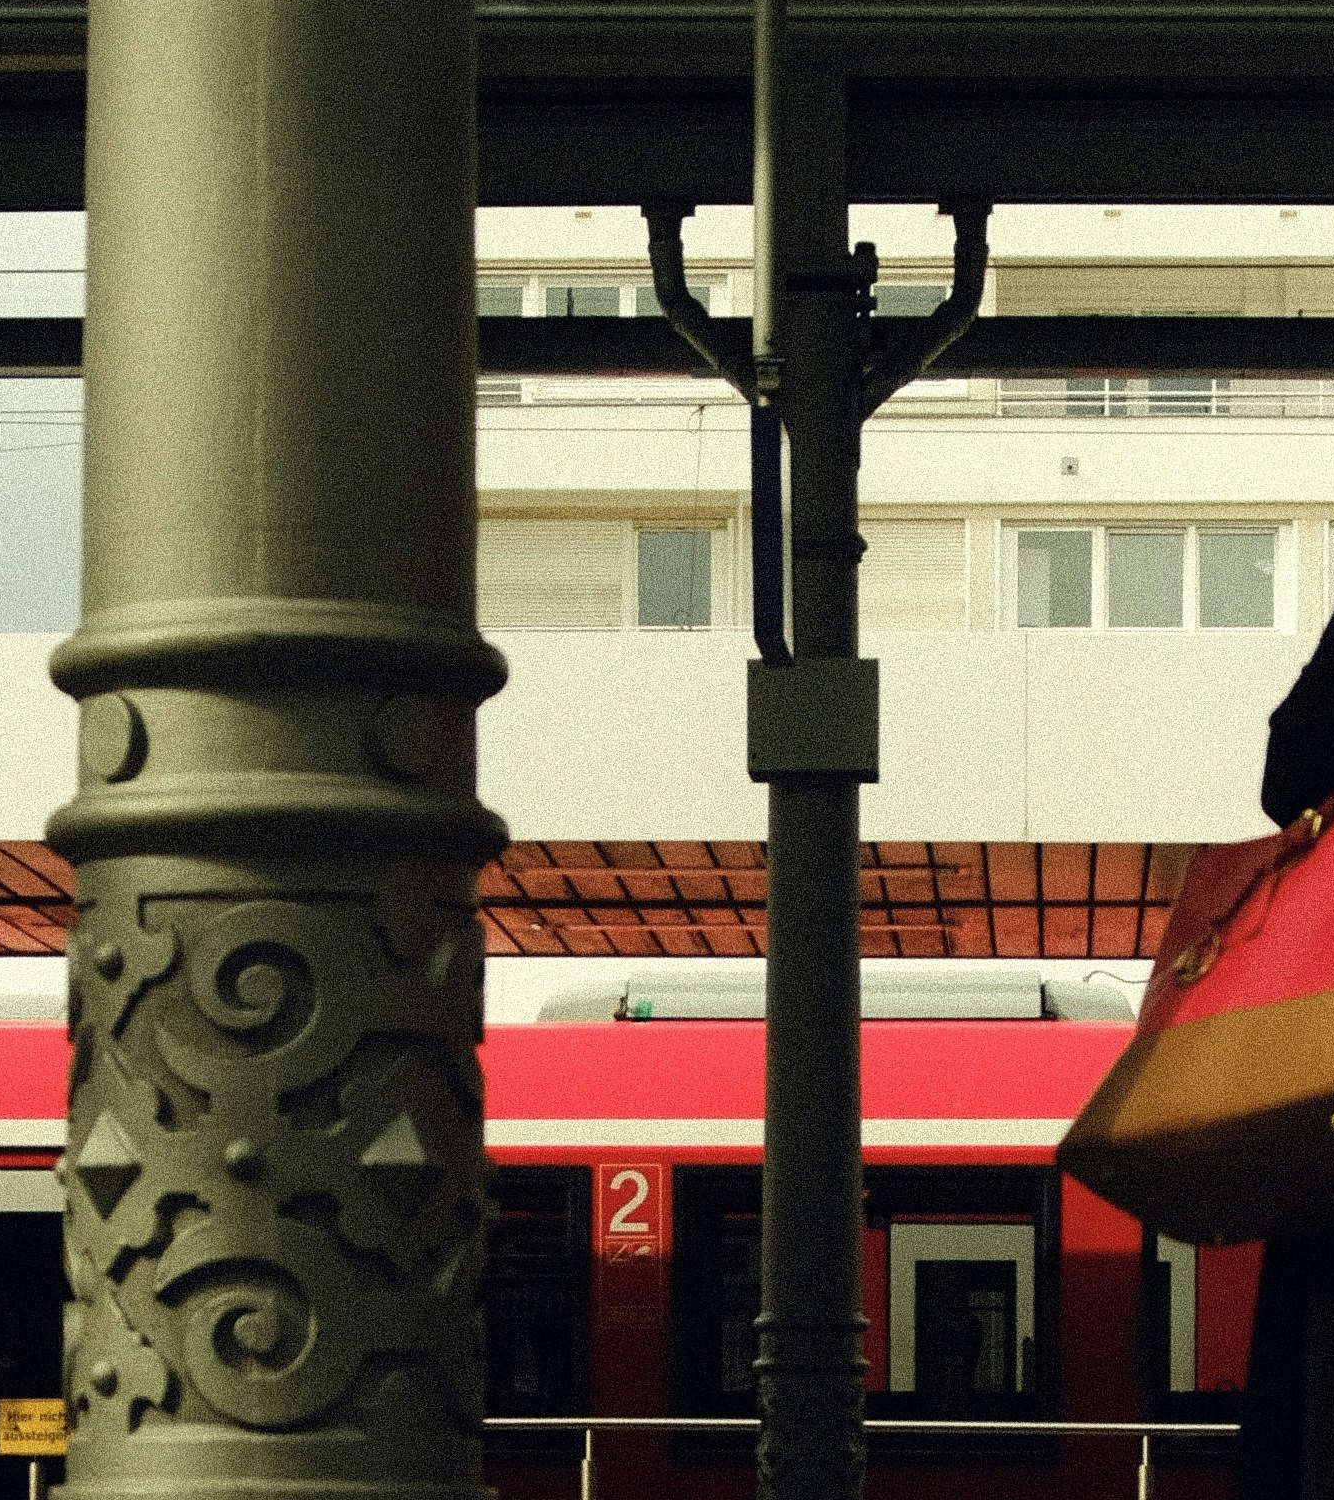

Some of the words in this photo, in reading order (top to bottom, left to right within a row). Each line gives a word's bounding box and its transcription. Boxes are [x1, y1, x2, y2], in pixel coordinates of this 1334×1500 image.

[609, 1169, 650, 1233] 2
[7, 1411, 34, 1422] Hier
[39, 1411, 66, 1422] nich
